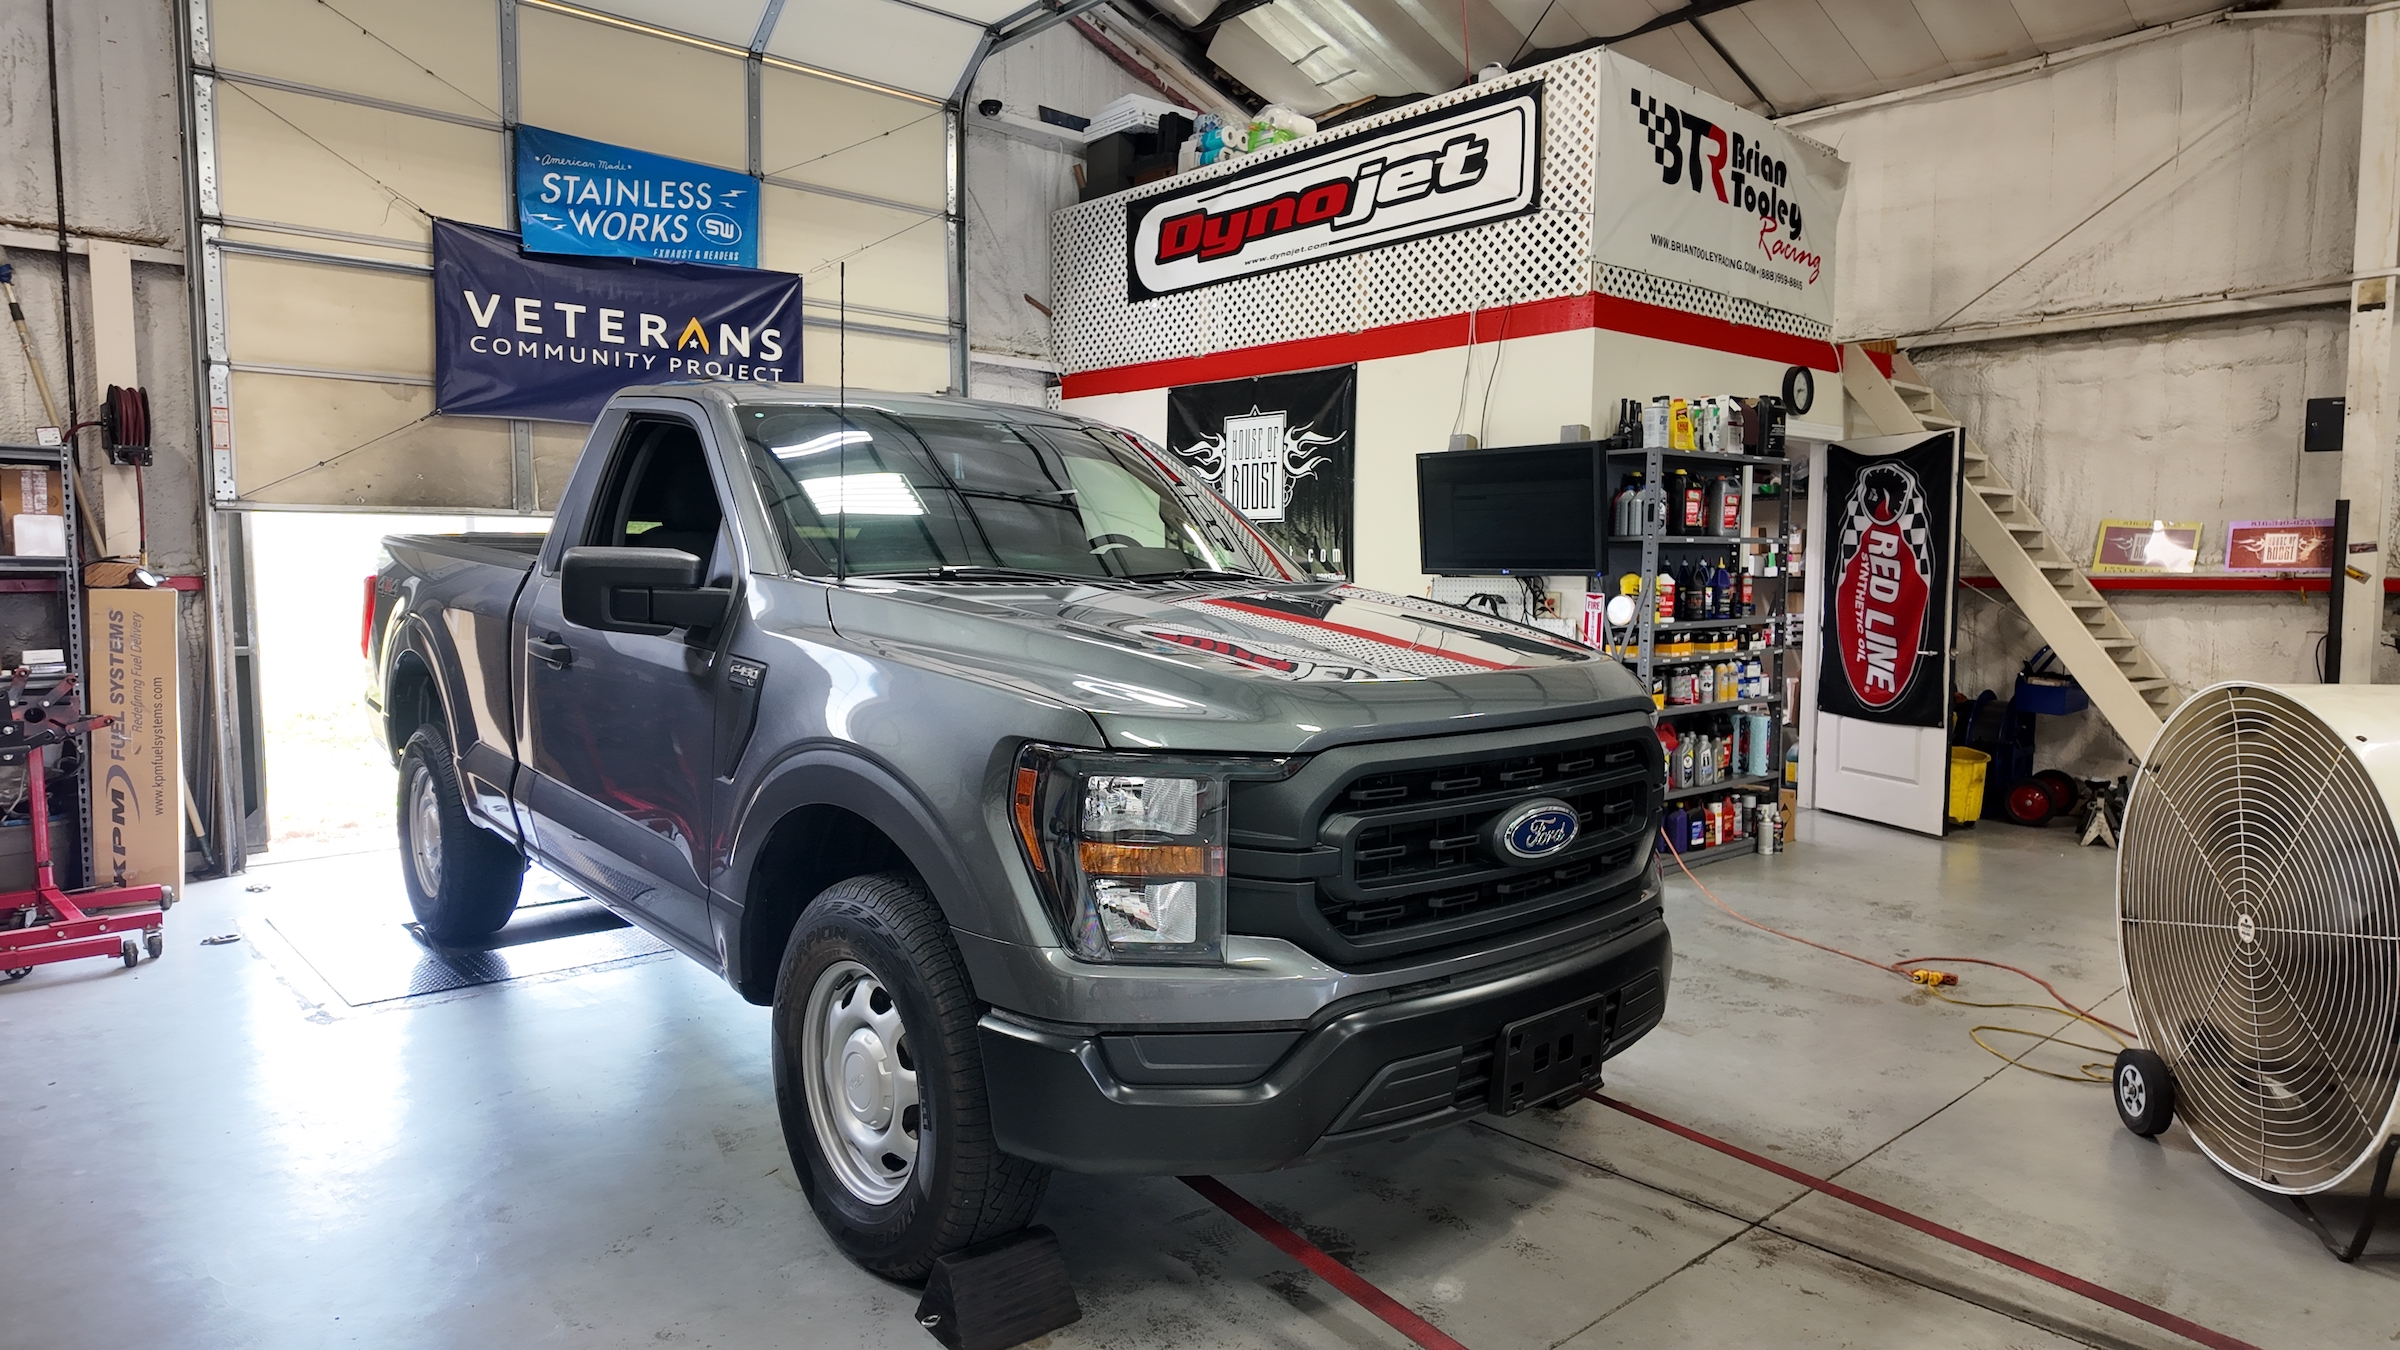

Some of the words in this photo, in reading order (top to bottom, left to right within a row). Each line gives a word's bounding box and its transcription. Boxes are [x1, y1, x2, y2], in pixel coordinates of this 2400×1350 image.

[541, 154, 596, 169] American
[598, 159, 627, 171] Made
[1643, 97, 1729, 204] BTR
[1732, 131, 1787, 188] Brian
[540, 172, 712, 210] STAINLESS
[1158, 136, 1487, 263] Dynojet
[1731, 170, 1802, 240] Tooley
[567, 208, 688, 243] WORKS
[1758, 215, 1821, 285] Racing
[653, 248, 692, 260] EXHAUST
[703, 250, 740, 261] HEADERS
[1244, 242, 1329, 266] www.dynojet.com
[463, 290, 784, 362] VETERANS
[470, 335, 656, 371] COMMUNITY
[669, 357, 784, 383] PROJECT
[1232, 427, 1263, 461] HOUSE
[1267, 425, 1279, 459] OF
[1231, 461, 1278, 510] BOOST
[1867, 529, 1900, 603] RED
[1587, 601, 1600, 610] FIRE
[1854, 552, 1868, 634] SYNTHETIC
[108, 609, 125, 705] SYSTEMS
[130, 611, 145, 653] Delivery
[1856, 636, 1867, 664] OIL
[1864, 608, 1898, 695] LINE
[131, 654, 143, 677] Fuel
[130, 680, 146, 733] Redefining
[110, 711, 126, 761] FUEL
[151, 677, 167, 816] www.kpmfuelsystems.com
[111, 787, 127, 889] KPM
[1525, 816, 1566, 848] Ford
